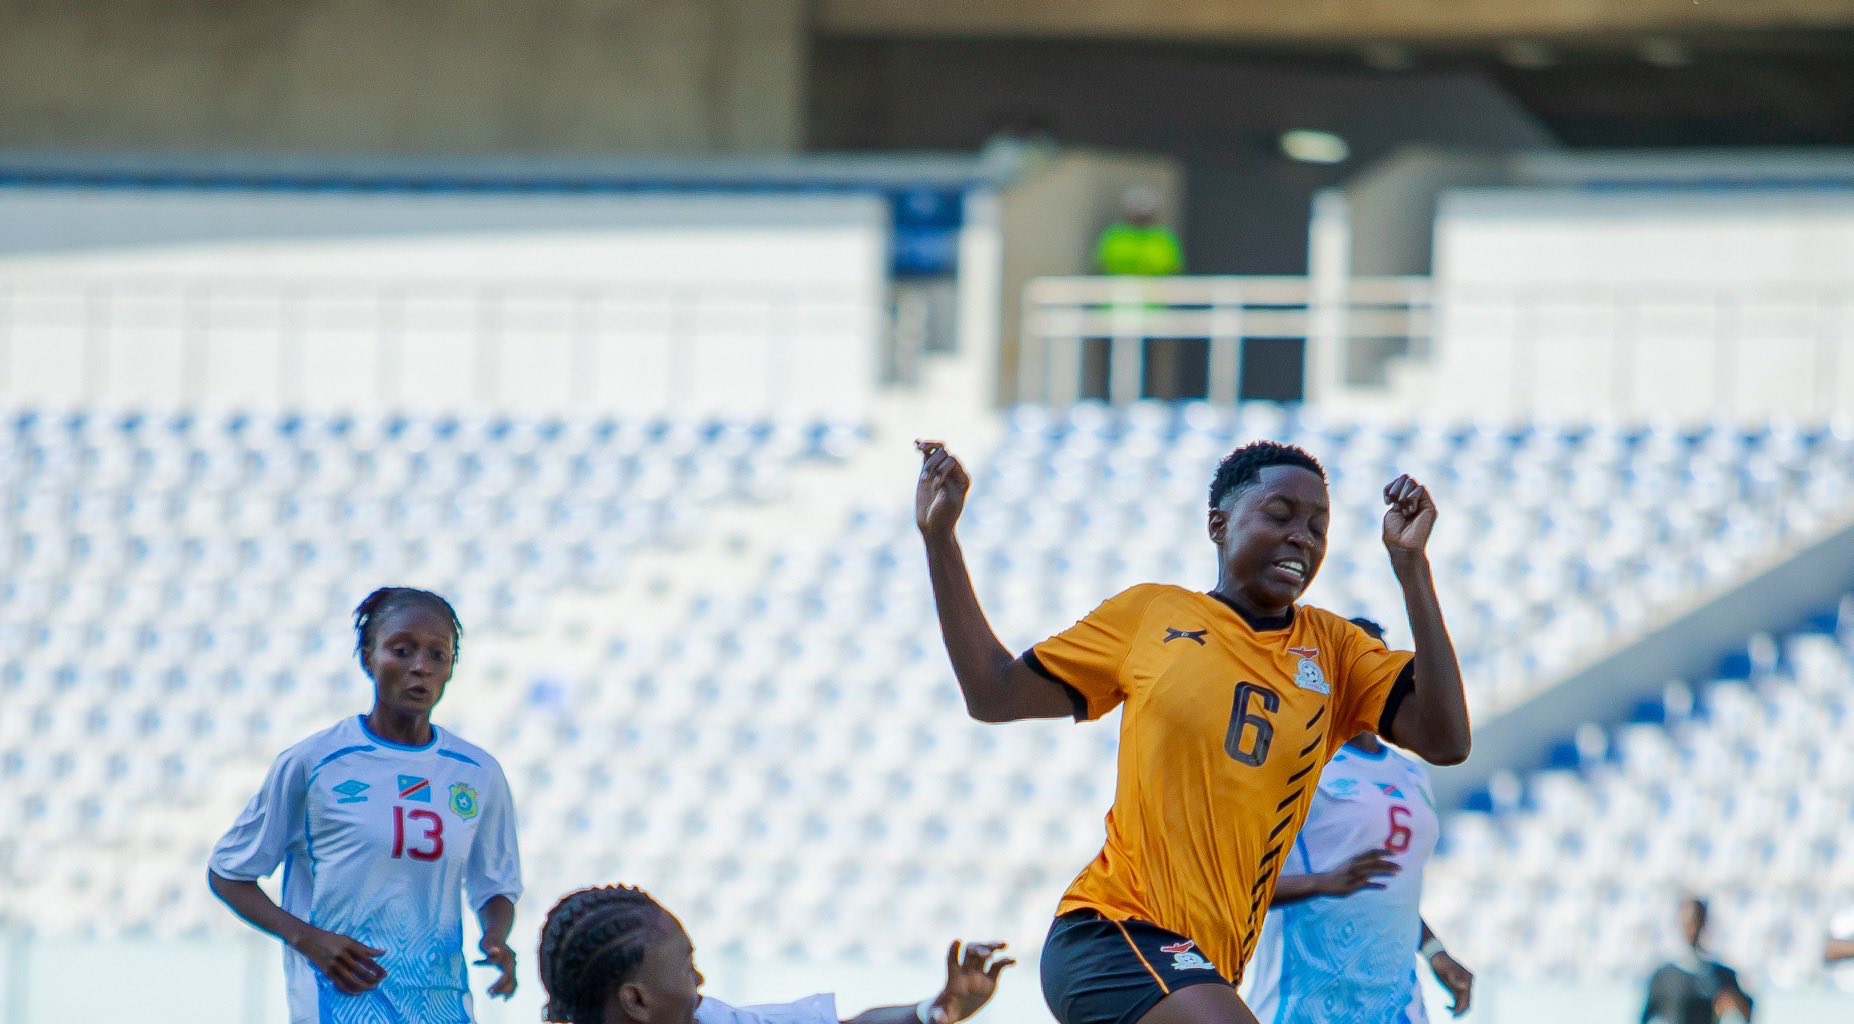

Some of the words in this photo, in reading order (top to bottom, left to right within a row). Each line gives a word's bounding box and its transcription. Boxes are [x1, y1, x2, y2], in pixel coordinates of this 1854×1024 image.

[1224, 681, 1280, 767] 6
[391, 806, 444, 861] 13
[1385, 805, 1412, 853] 6
